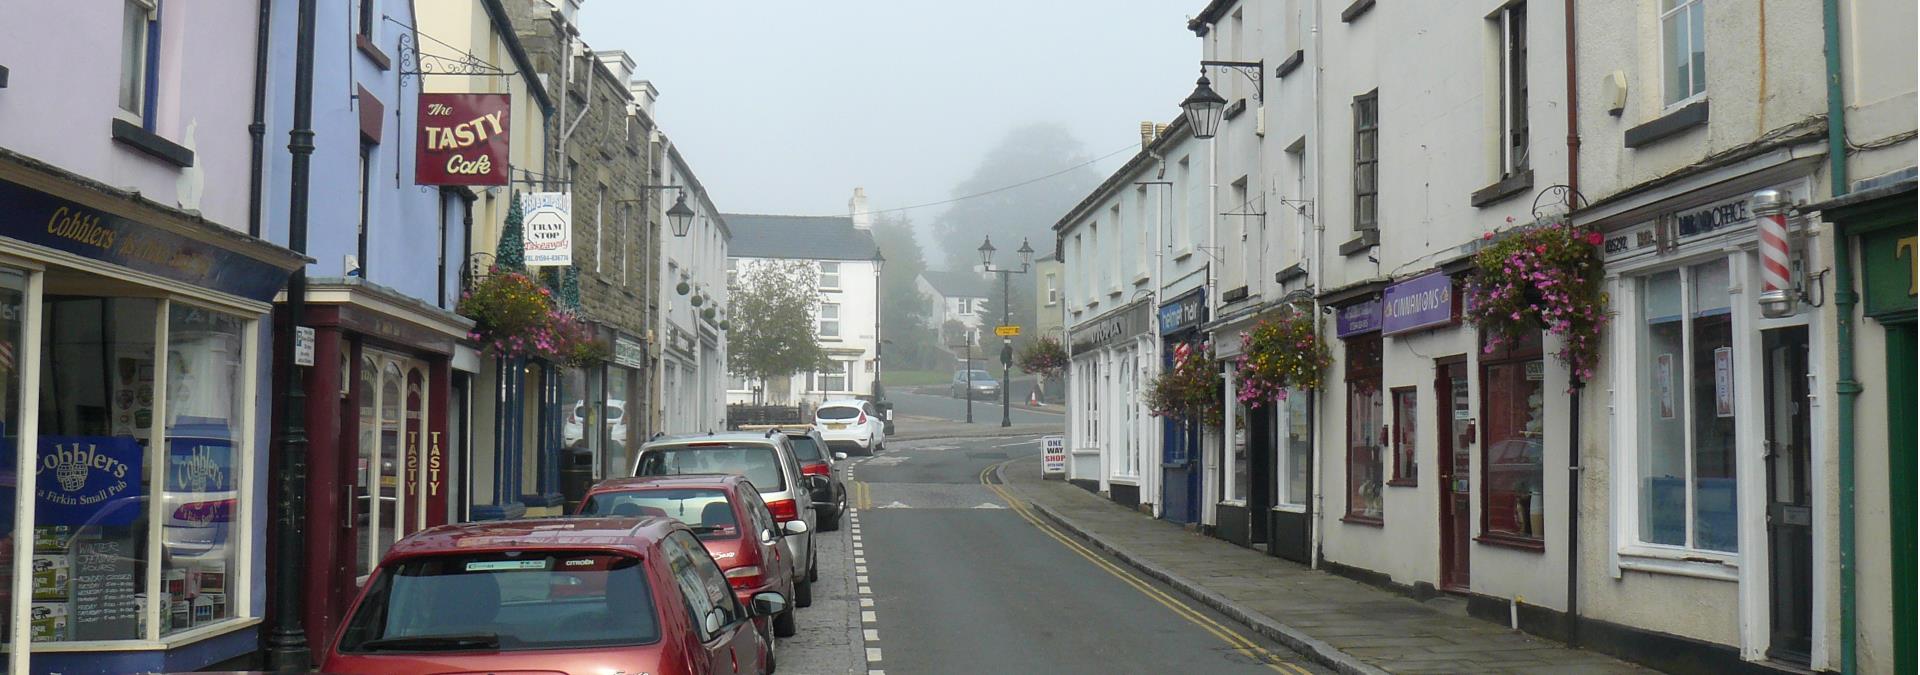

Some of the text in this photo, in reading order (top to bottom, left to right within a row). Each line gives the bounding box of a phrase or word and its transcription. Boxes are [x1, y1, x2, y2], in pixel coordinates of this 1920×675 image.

[427, 103, 453, 116] The
[425, 110, 504, 150] TASTY
[446, 154, 492, 175] Cafe
[532, 223, 562, 231] TRAM
[1712, 200, 1747, 228] OFFICE
[47, 206, 118, 249] Cobblers
[534, 232, 560, 240] STOP
[1393, 287, 1440, 318] CINNAMONS
[1046, 447, 1063, 455] WAY
[1047, 439, 1062, 447] ONE
[178, 445, 224, 491] Cobblers
[429, 431, 441, 496] TASTY
[46, 490, 77, 505] Firkin
[79, 489, 108, 505] Small
[107, 479, 127, 496] Pub
